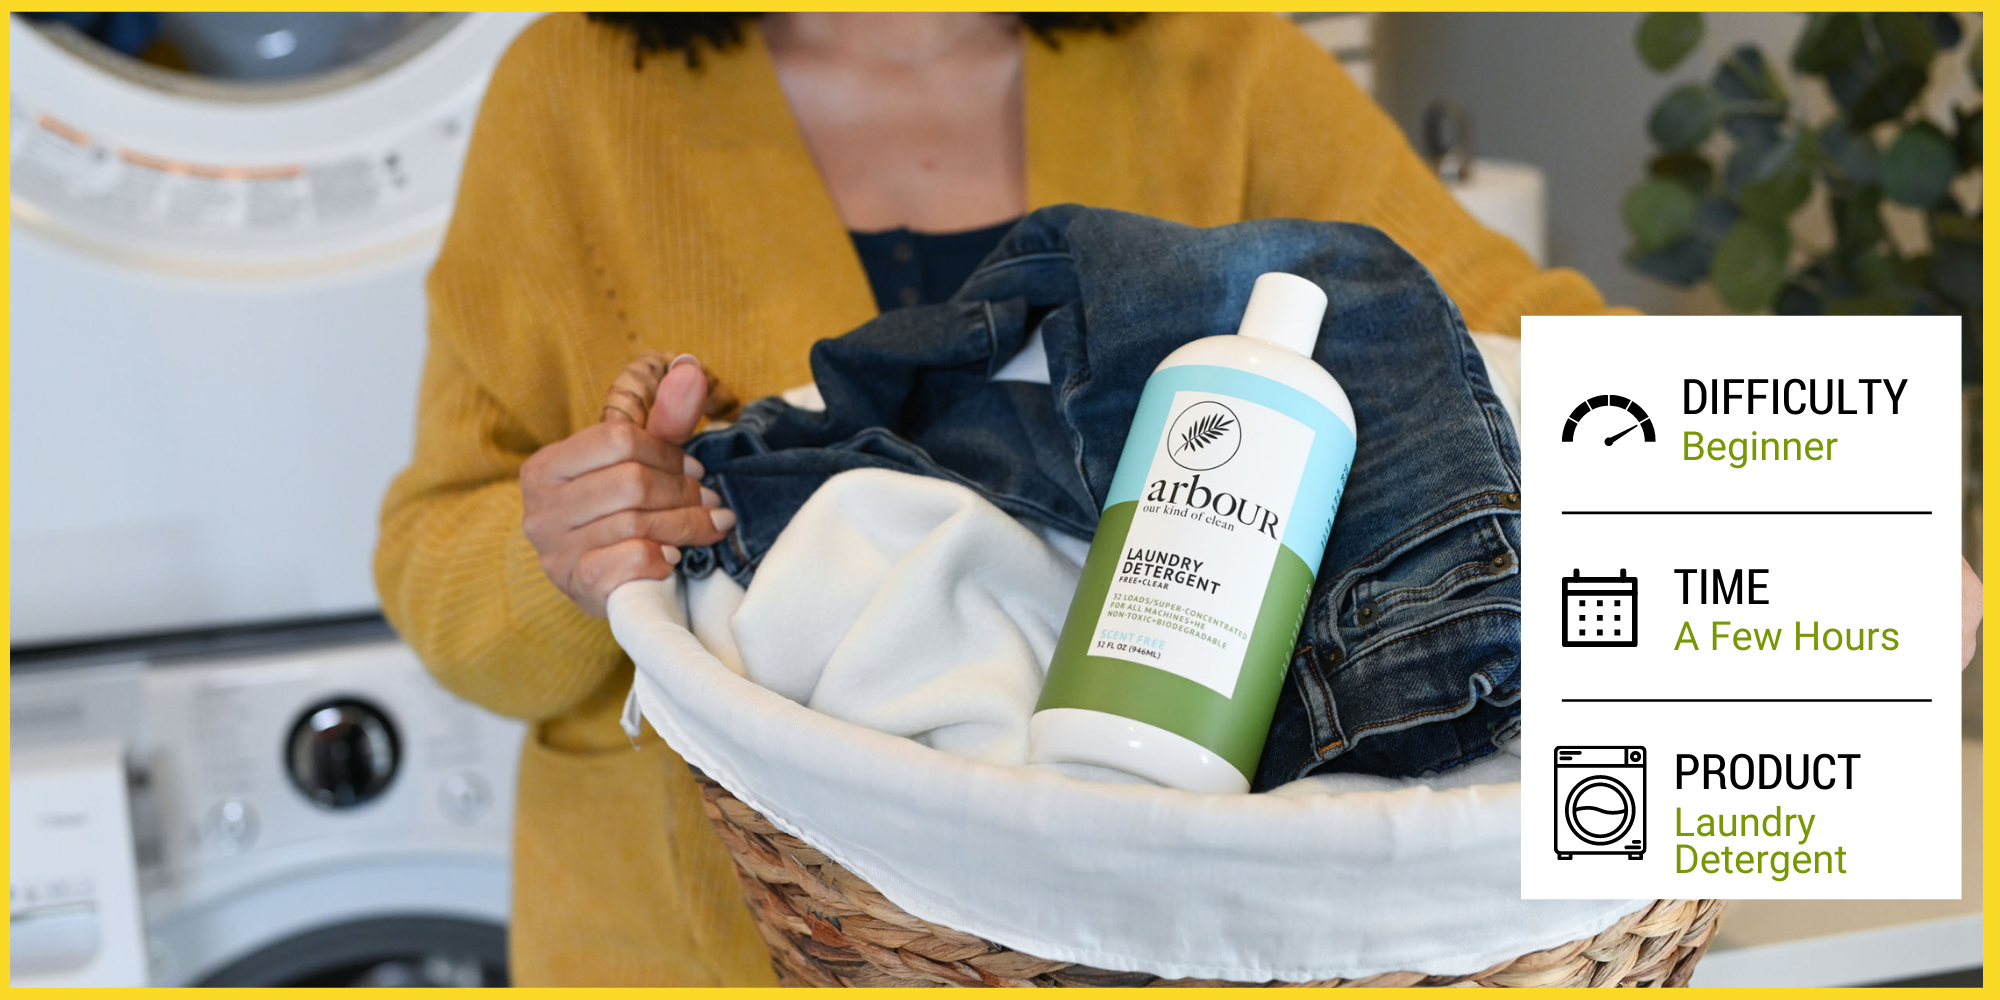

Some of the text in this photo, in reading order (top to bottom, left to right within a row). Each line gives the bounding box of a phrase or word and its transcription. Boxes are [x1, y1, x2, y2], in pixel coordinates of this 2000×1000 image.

[1143, 504, 1235, 532] our kind of clean
[1127, 548, 1204, 573] LAUNDRY
[1118, 576, 1169, 590] FREE+CLEAR
[1122, 561, 1221, 595] DETERGENT
[1107, 610, 1228, 650] NON-TOXIC+BIODEGRADABLE
[1123, 594, 1248, 640] LOADS/SUPER-CONCENTRATED
[1126, 604, 1142, 612] ALL
[1144, 606, 1206, 630] MACHINES+HE
[1096, 640, 1161, 660] 32 FL OZ (946ML)
[1100, 629, 1166, 650] SCENT FREE
